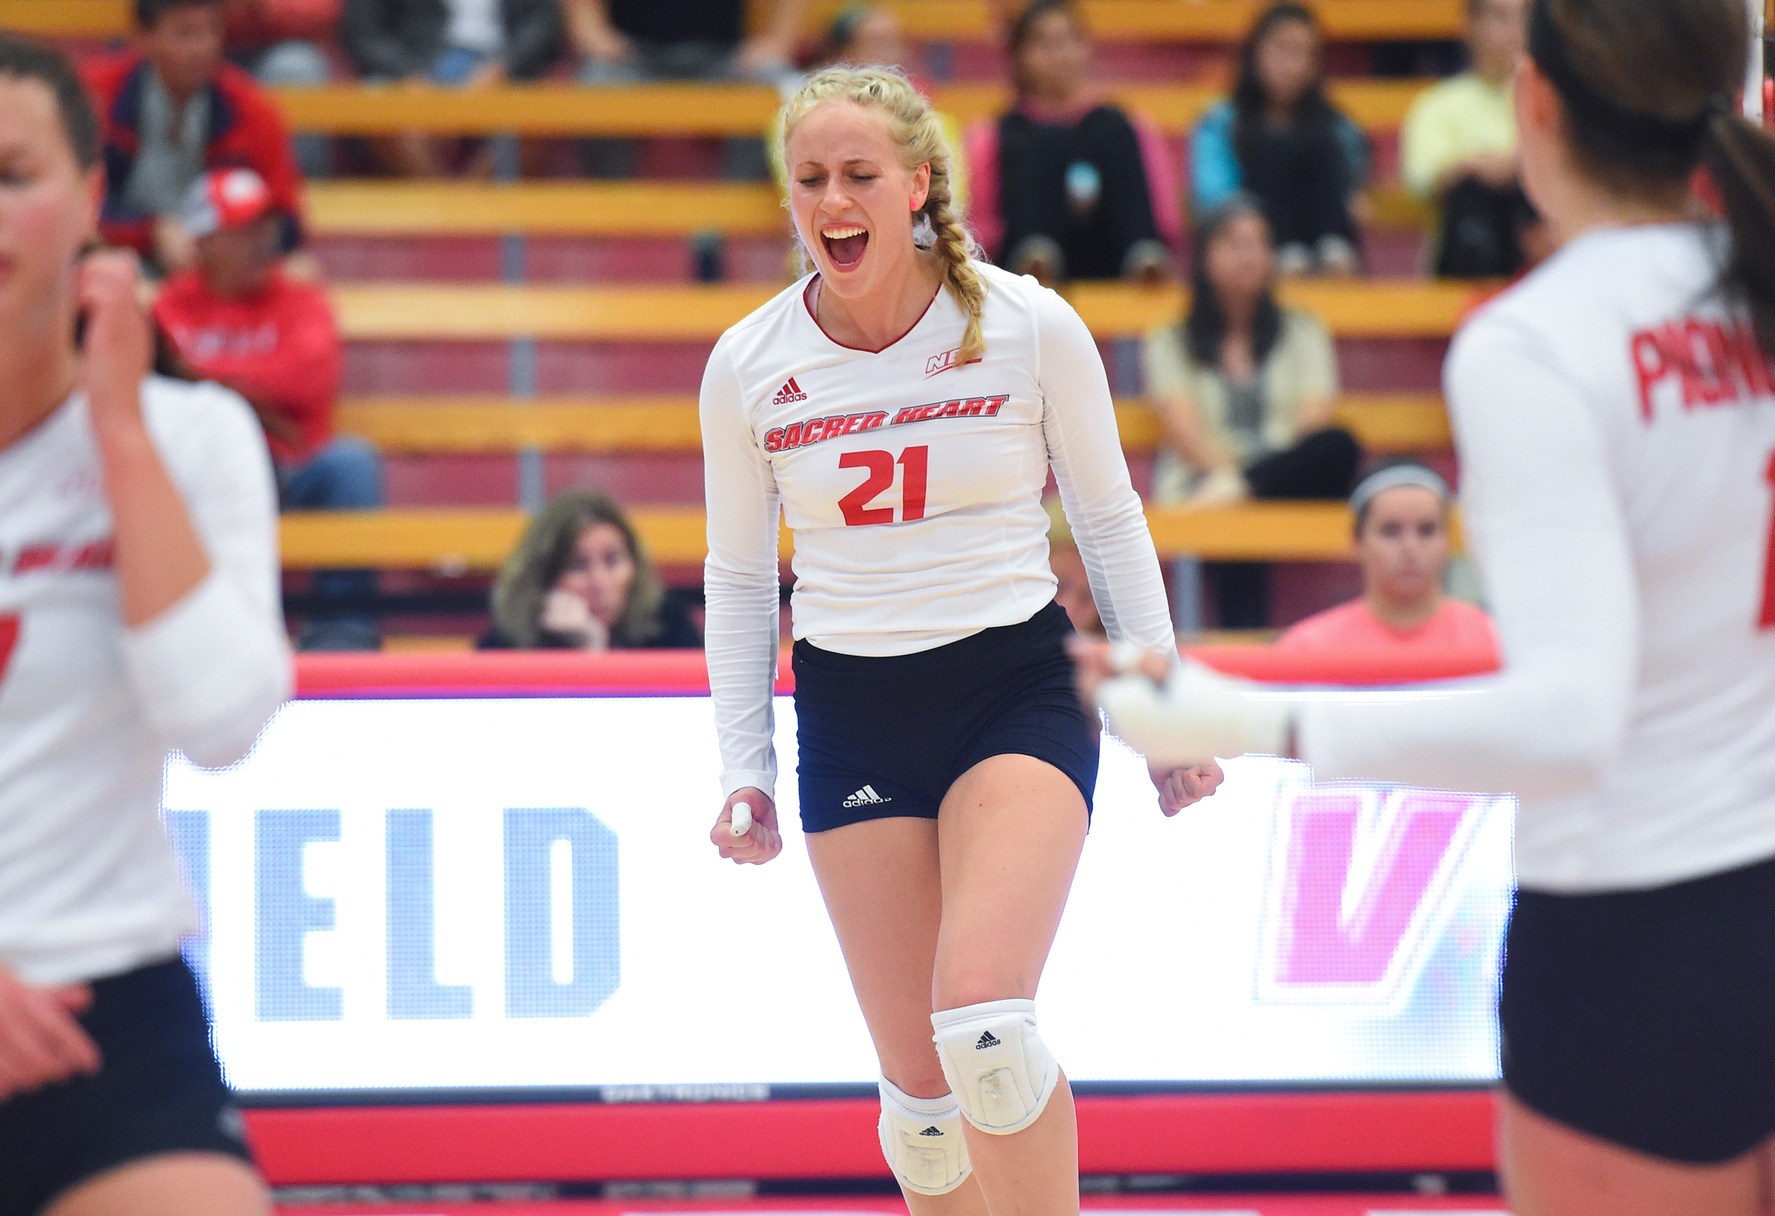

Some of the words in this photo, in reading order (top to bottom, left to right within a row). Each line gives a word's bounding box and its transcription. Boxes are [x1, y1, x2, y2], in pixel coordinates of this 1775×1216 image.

[764, 410, 889, 453] SACRED
[890, 394, 1010, 425] HEART
[773, 392, 807, 405] adidas
[837, 445, 928, 526] 21
